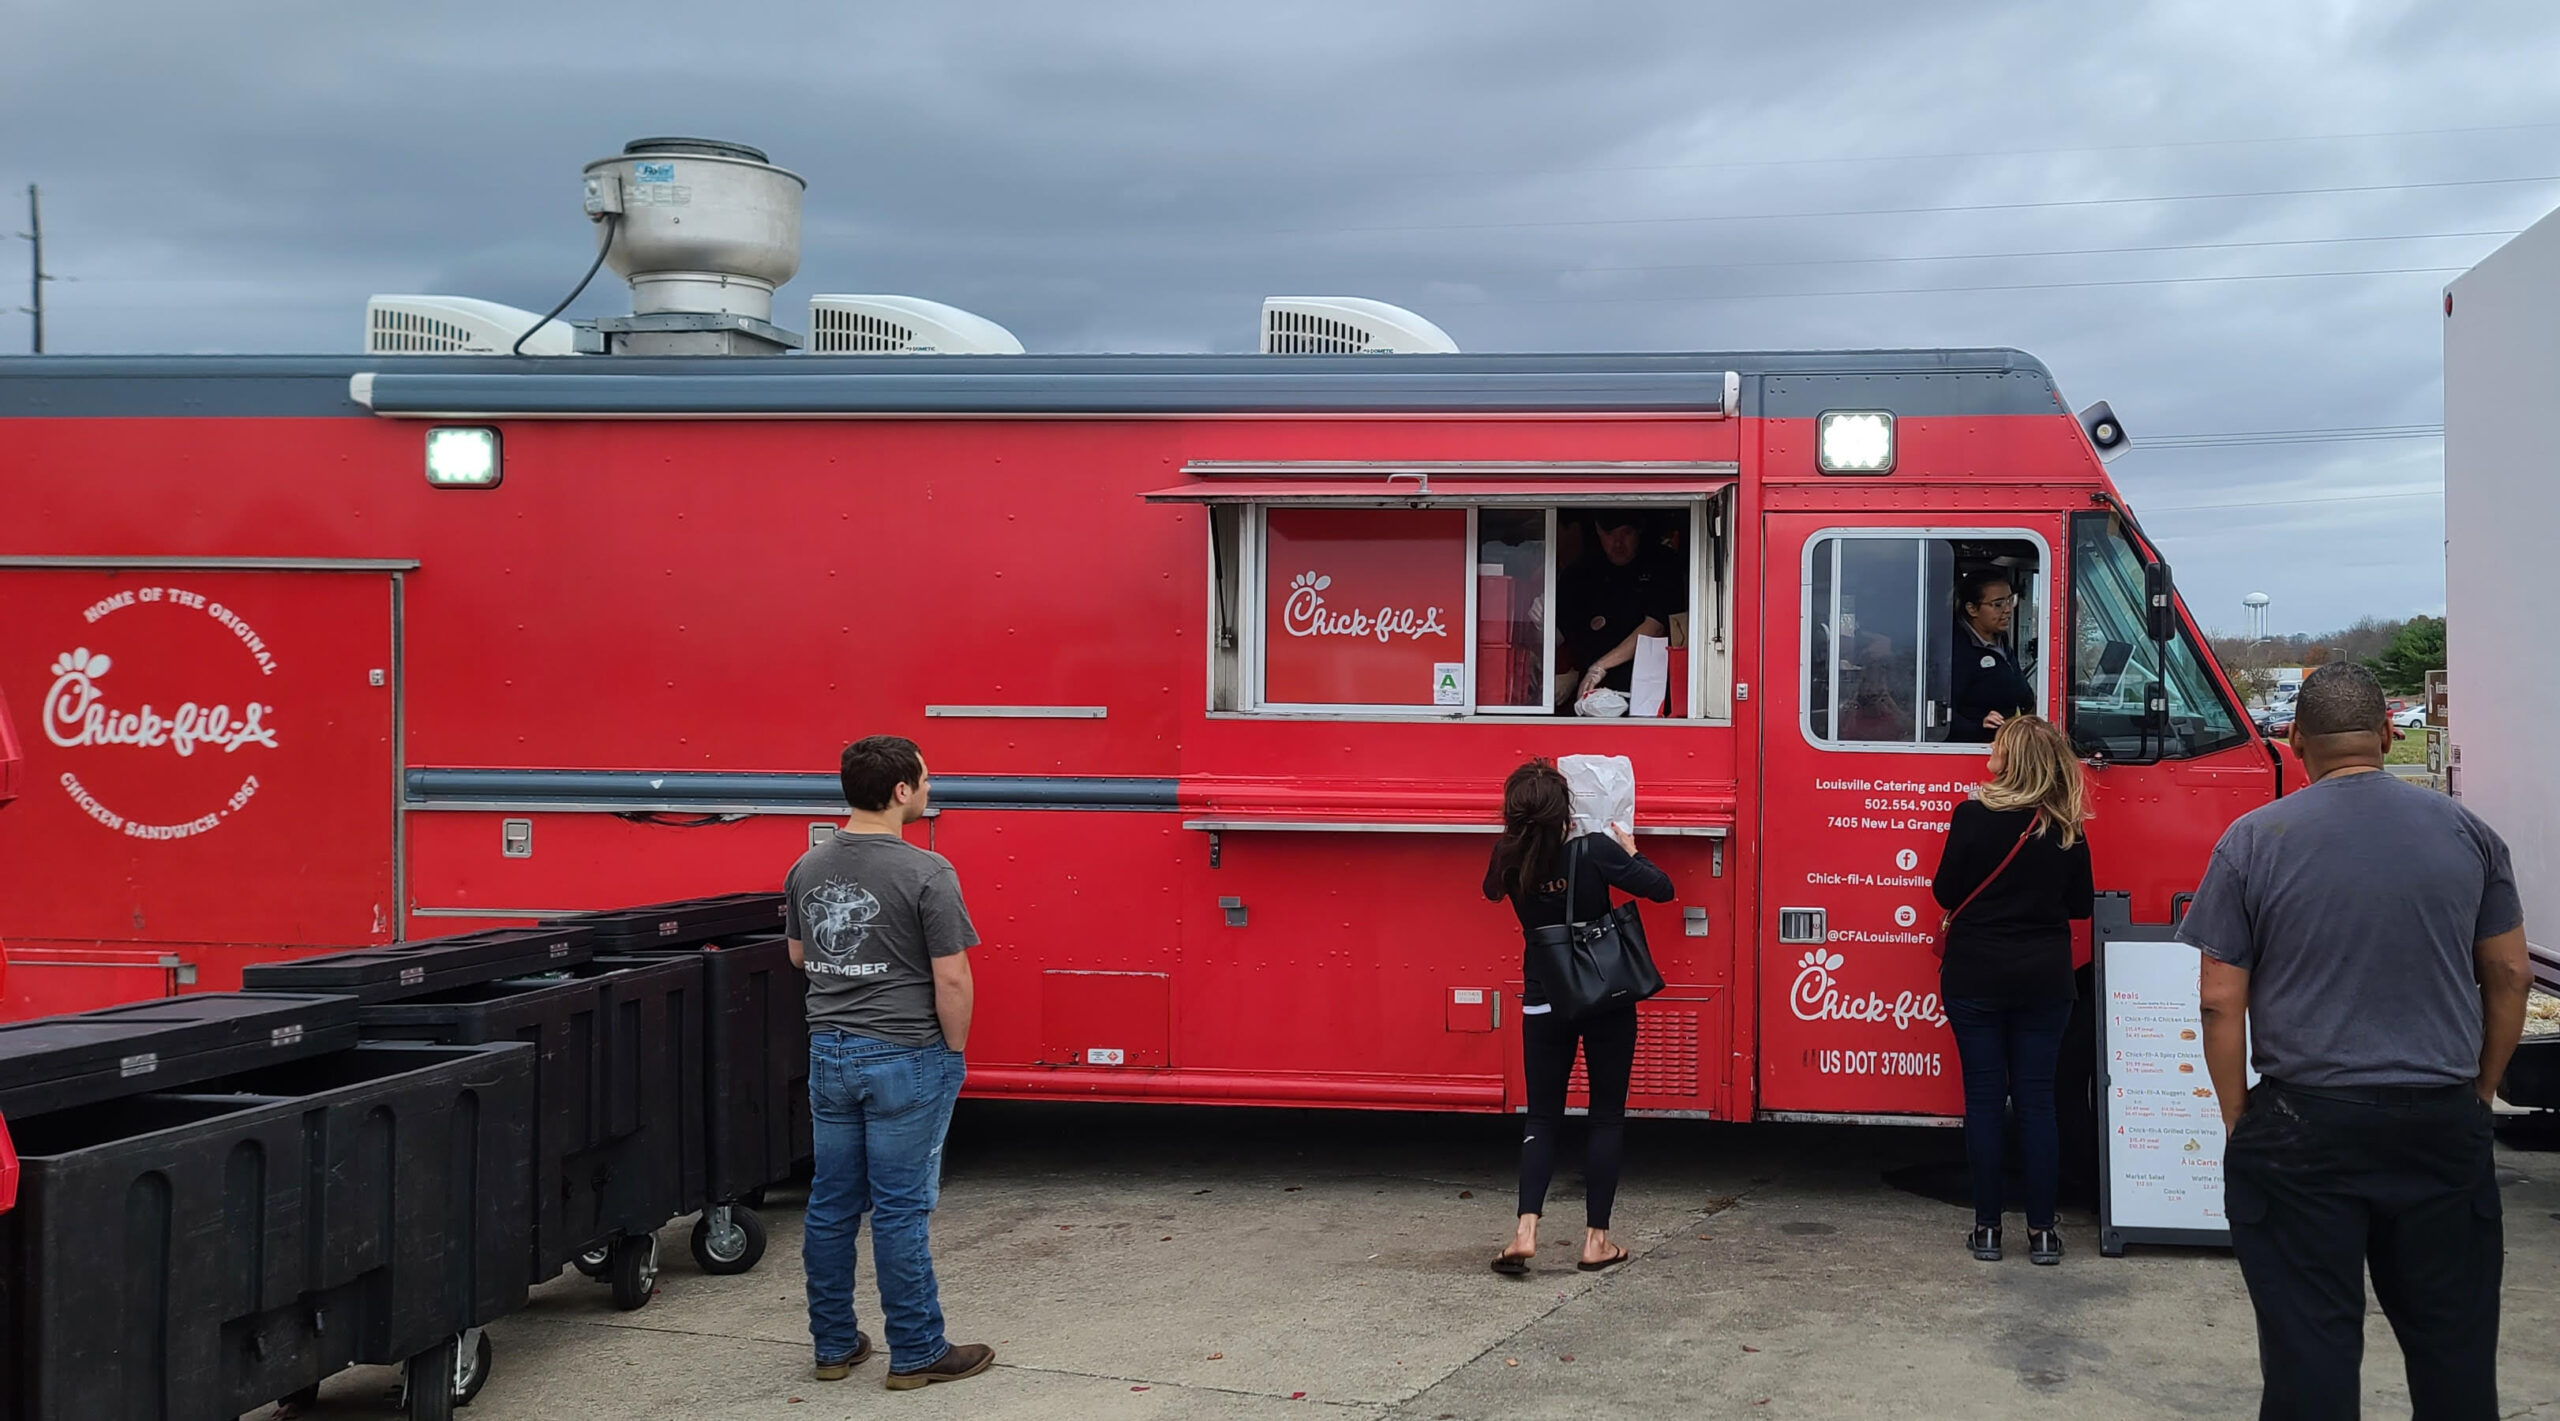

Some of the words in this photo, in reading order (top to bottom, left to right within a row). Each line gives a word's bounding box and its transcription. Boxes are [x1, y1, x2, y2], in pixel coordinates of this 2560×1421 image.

[1283, 585, 1447, 643] Chick-fil-A
[83, 590, 135, 623] HOME
[139, 587, 163, 602] OF
[168, 588, 206, 609] THE
[208, 603, 278, 675] ORIGINAL
[1440, 674, 1457, 689] A
[43, 671, 279, 757] Chick-fil-A
[1815, 778, 1872, 791] Louisville
[1874, 779, 1926, 795] Catering
[1928, 781, 1951, 793] and
[60, 772, 124, 830] CHICKEN
[124, 812, 221, 840] SANDWICH
[227, 775, 260, 812] 1967
[1864, 798, 1952, 812] 502.554.9030
[1827, 816, 1858, 828] 7405
[1861, 817, 1888, 829] New
[1890, 818, 1905, 830] La
[1907, 818, 1951, 833] Grange
[1806, 872, 1874, 886] Chick-fil-A
[1876, 874, 1932, 887] Louisville
[1827, 930, 1934, 945] @CFALouisvilleFo
[2113, 991, 2139, 1000] Meals
[2115, 1016, 2120, 1026] 1
[2116, 1050, 2122, 1060] 2
[1820, 1050, 1841, 1074] US
[1845, 1050, 1877, 1075] DOT
[1881, 1051, 1941, 1077] 3780015
[2116, 1088, 2123, 1098] 3
[2117, 1125, 2124, 1135] 4
